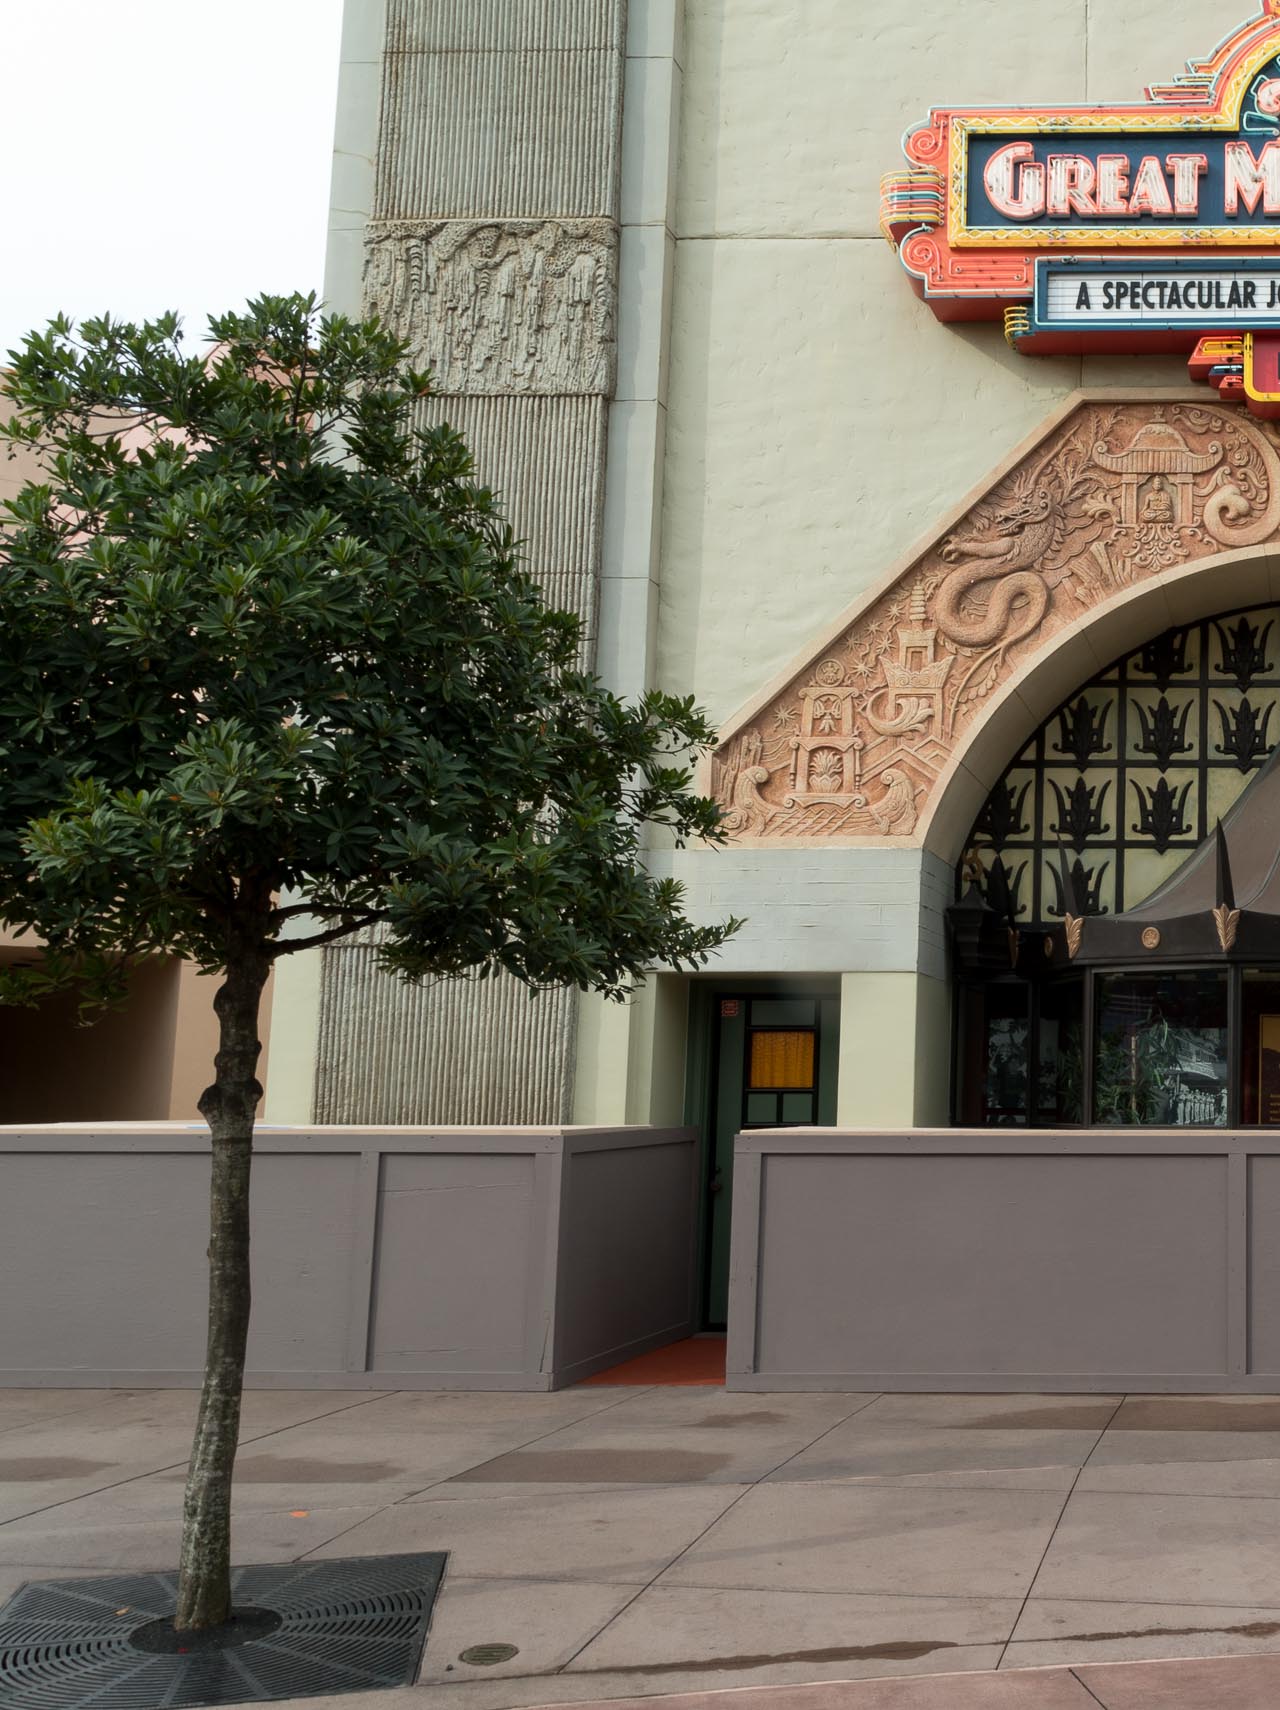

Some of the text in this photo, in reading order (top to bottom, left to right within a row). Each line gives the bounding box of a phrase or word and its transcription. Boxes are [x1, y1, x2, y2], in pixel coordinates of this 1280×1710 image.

[984, 141, 1208, 221] GREAT
[1075, 281, 1091, 310] A
[1102, 280, 1256, 310] SPECTACULAR
